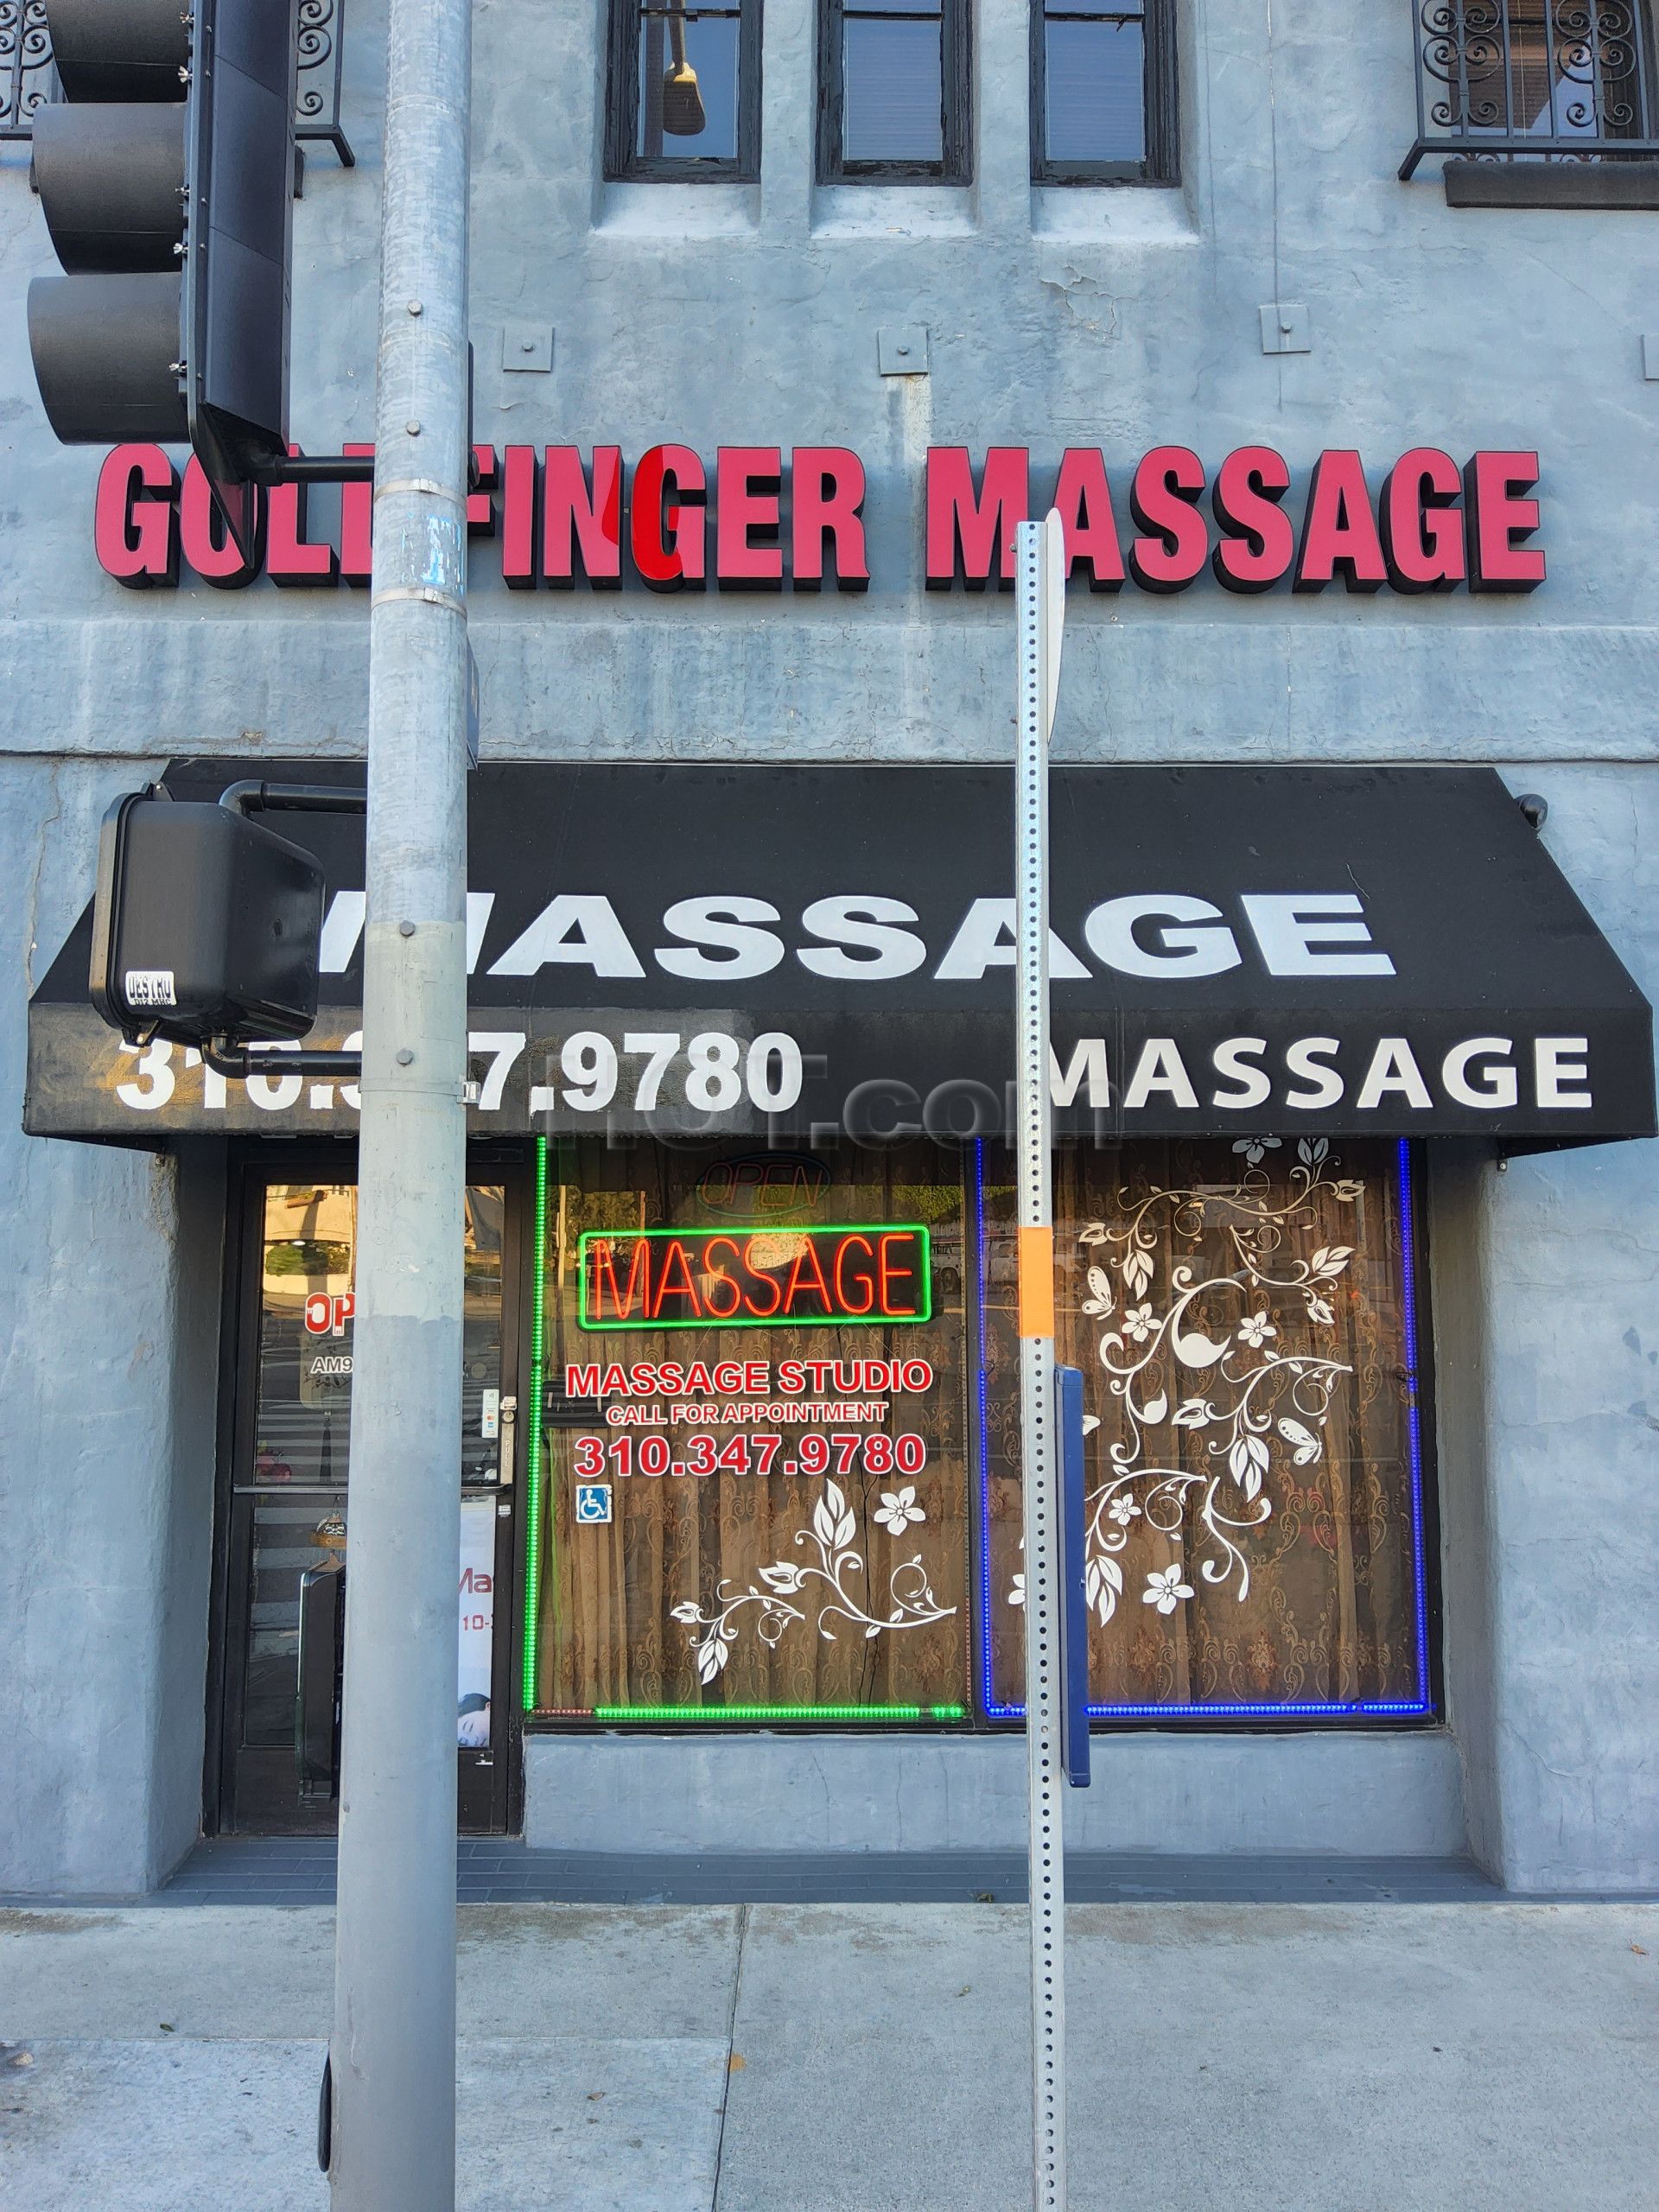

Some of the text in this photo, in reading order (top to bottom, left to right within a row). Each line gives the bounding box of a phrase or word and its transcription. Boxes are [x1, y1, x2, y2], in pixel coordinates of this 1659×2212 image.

[925, 446, 1546, 591] MASSAGE
[116, 1031, 1592, 1114] 310.7.9780 MASSAGE
[700, 1160, 825, 1208] OPEN
[594, 1232, 917, 1320] MASSAGE
[305, 1292, 356, 1337] OP
[565, 1358, 934, 1399] MASSAGE STUDIO
[607, 1402, 890, 1426] CALL FOR APPOINTMENT
[574, 1433, 927, 1478] 310.347.9780
